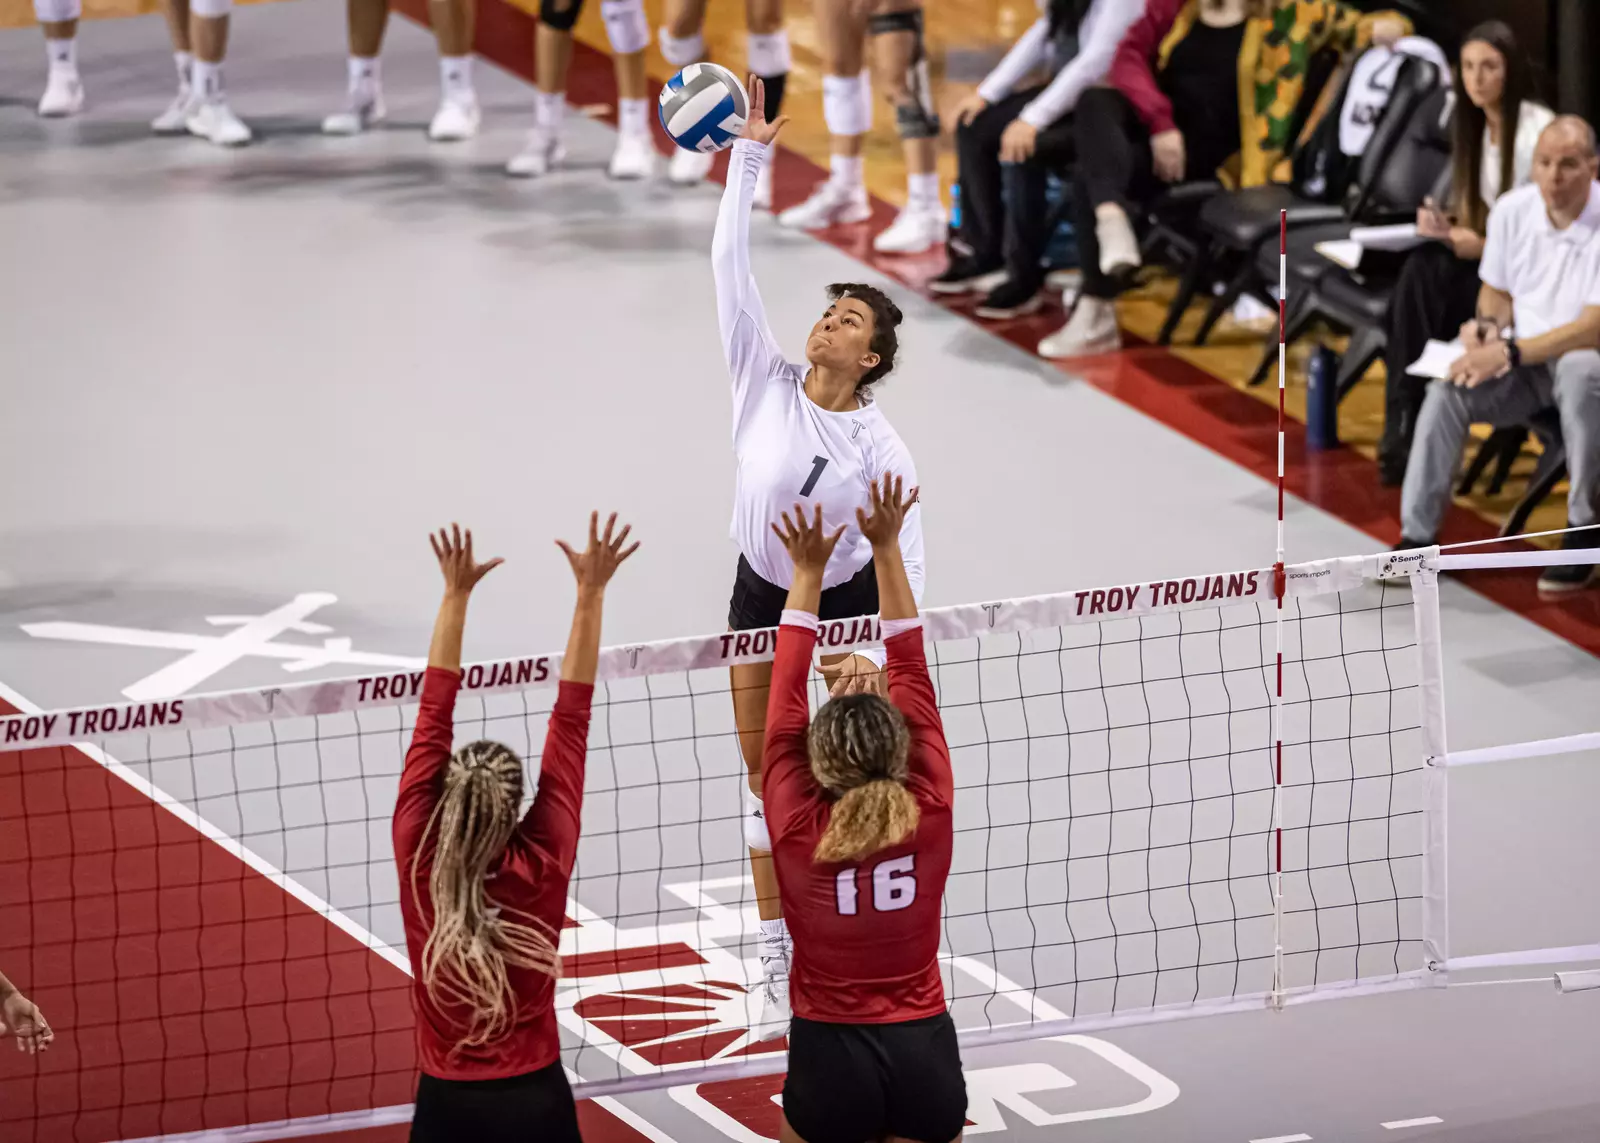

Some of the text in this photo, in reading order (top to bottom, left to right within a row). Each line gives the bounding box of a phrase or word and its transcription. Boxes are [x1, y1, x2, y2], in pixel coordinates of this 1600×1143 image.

[798, 455, 829, 498] 1
[1289, 569, 1331, 580] sports imports
[1397, 553, 1424, 563] Senoh
[1075, 570, 1259, 616] TROY TROJANS
[815, 616, 882, 648] ROJA
[357, 657, 549, 702] TROY OJANS
[0, 699, 184, 743] ROY TROJANS
[834, 852, 917, 915] 16
